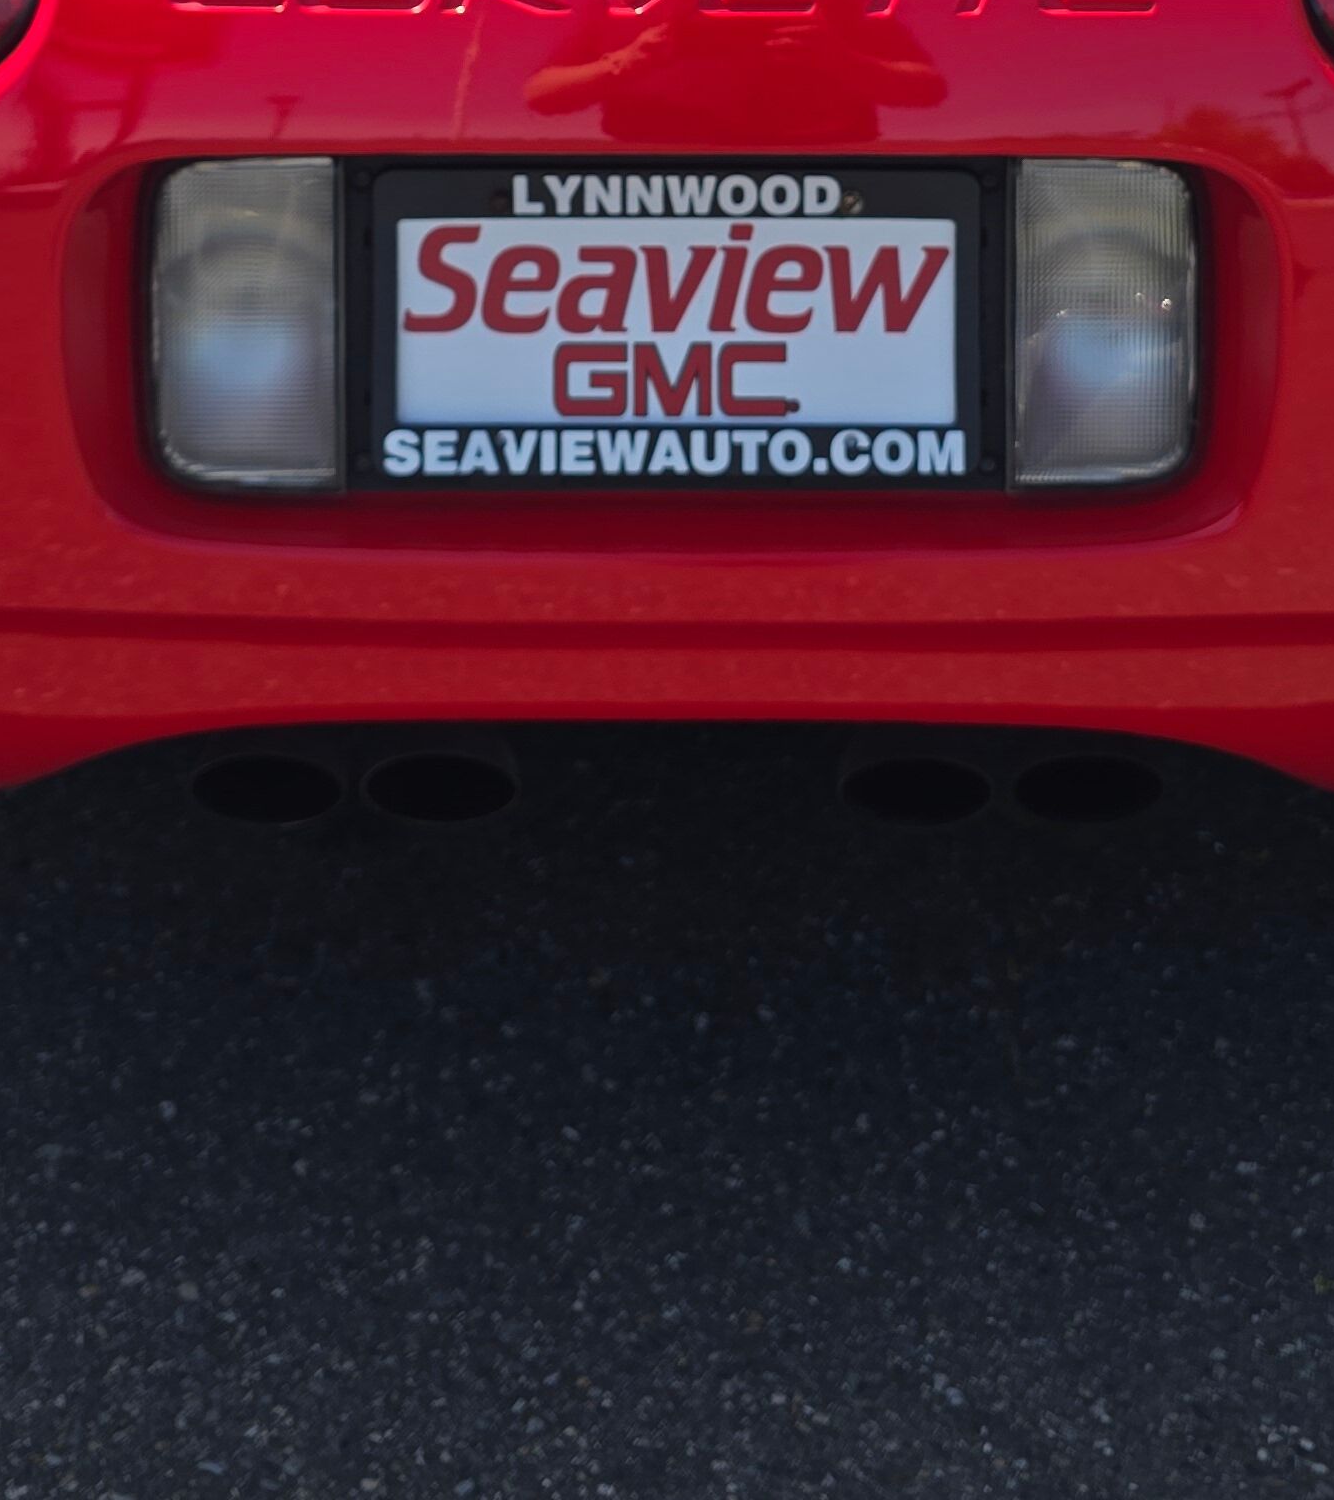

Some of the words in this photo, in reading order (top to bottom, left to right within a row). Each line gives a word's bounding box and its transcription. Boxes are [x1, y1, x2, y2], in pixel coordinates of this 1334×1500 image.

[513, 174, 842, 216] LYNNWOOD
[402, 222, 950, 334] Seaview
[552, 340, 789, 418] GMC
[382, 428, 967, 476] SEAVIEWAUTO.COM
